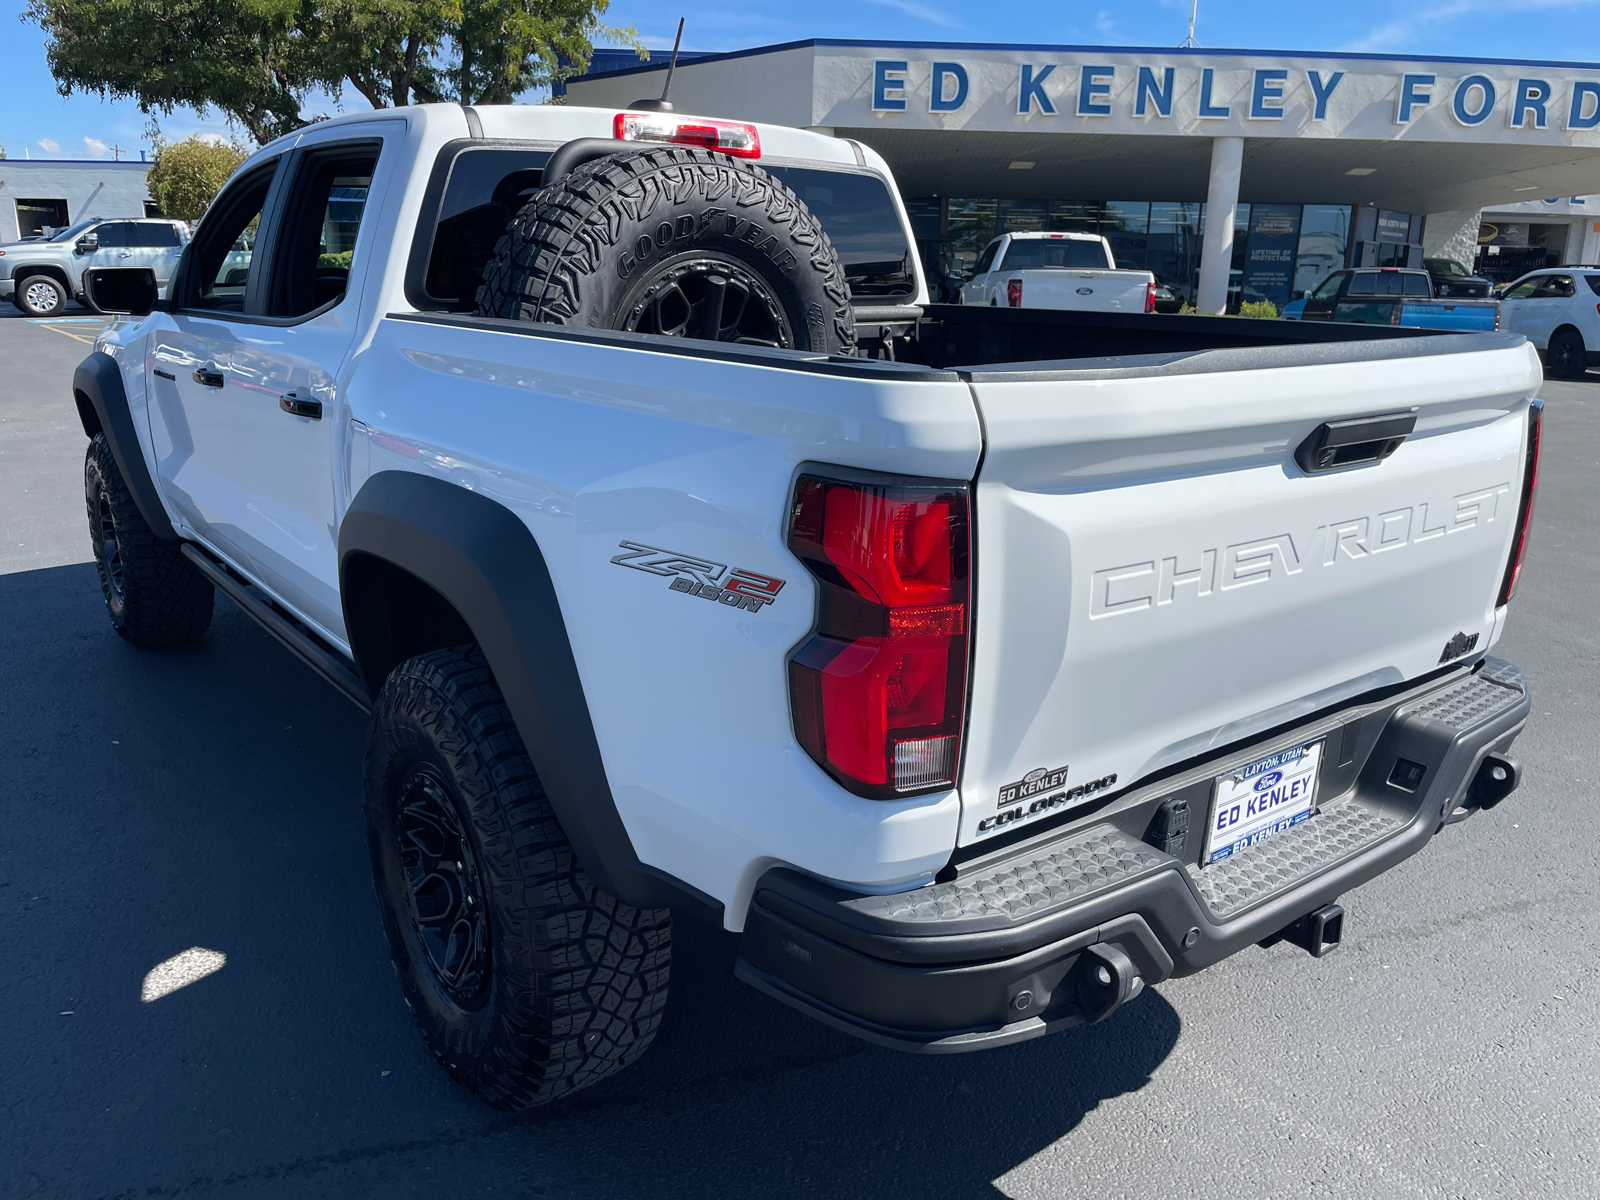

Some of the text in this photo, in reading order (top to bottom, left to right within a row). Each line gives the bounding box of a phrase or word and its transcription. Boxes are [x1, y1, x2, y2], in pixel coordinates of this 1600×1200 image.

[871, 60, 1600, 131] ED KENLEY FORD
[1405, 306, 1437, 314] NISSAN
[1089, 482, 1509, 620] CHEVROLET
[610, 539, 786, 605] ZR2
[669, 577, 765, 613] BISON
[1281, 747, 1303, 763] UTAH
[999, 771, 1067, 804] ED KENLEY
[1258, 773, 1279, 791] Ford
[978, 773, 1118, 832] COLORADO
[1217, 804, 1241, 830] ED
[1246, 775, 1312, 818] KENLEY
[1232, 838, 1248, 854] ED
[1250, 817, 1293, 846] KENLEY
